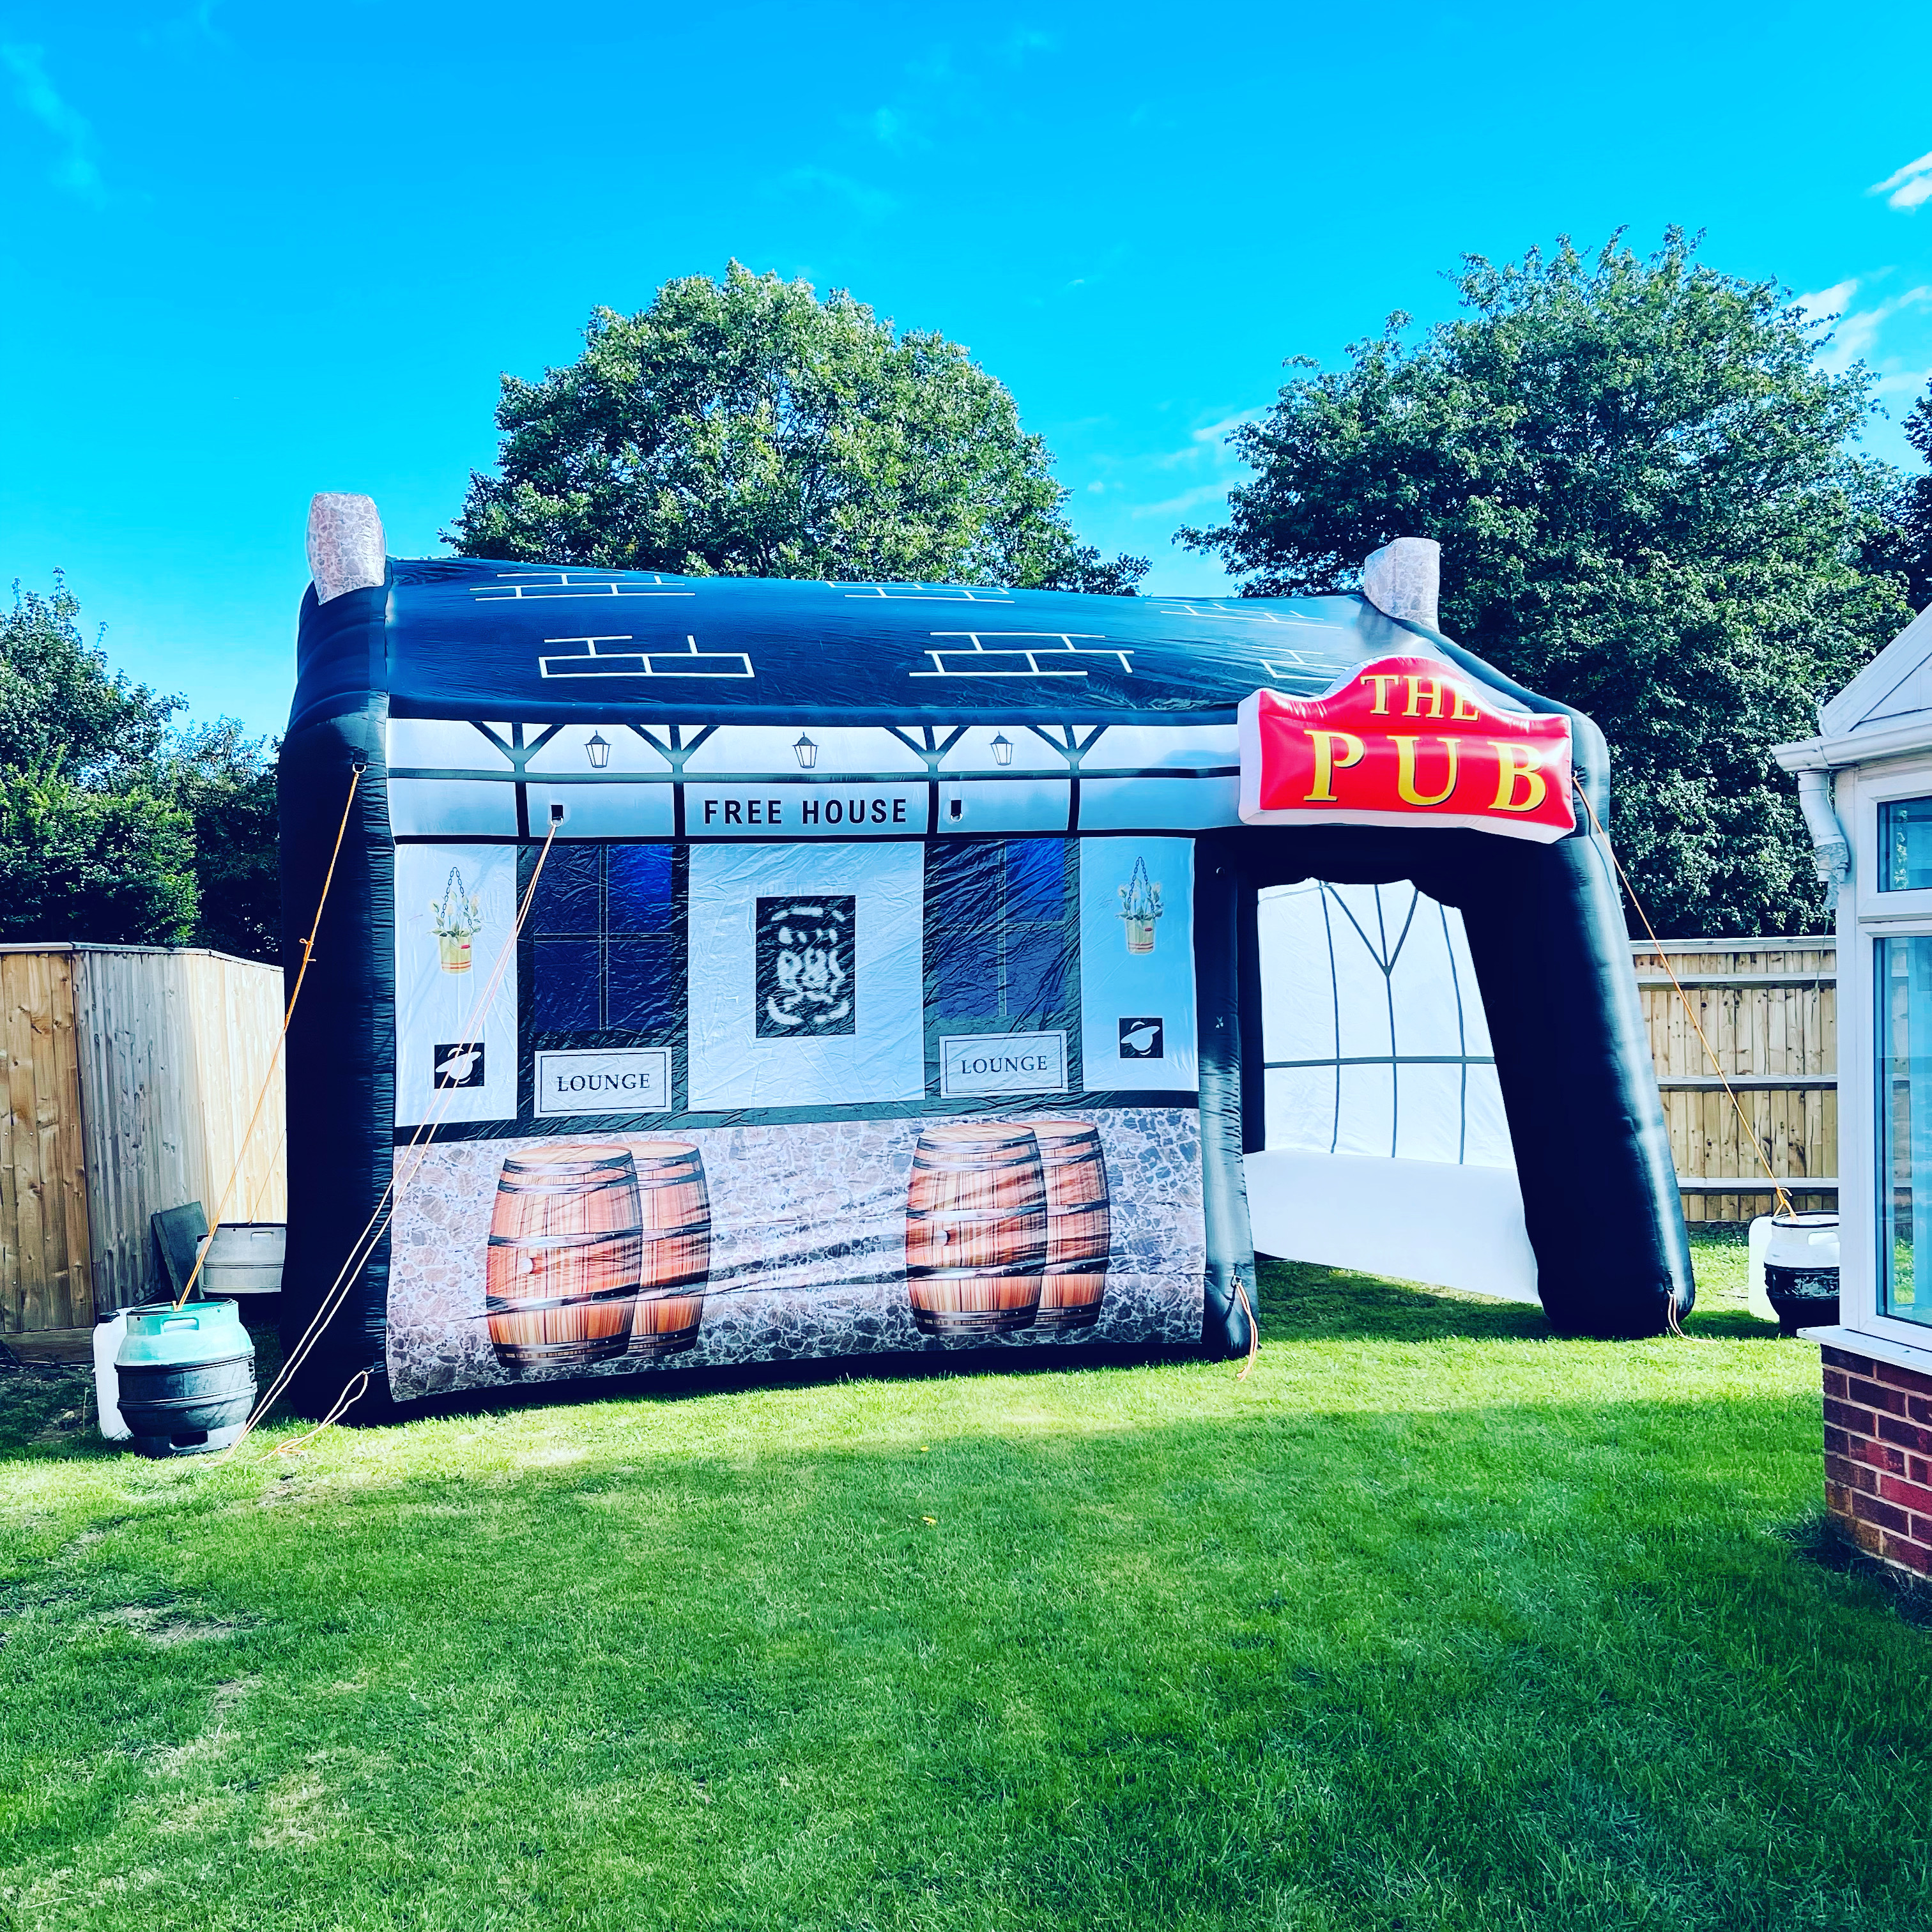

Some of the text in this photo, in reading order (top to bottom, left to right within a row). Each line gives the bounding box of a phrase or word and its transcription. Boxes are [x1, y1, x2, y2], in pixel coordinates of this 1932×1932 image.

[1361, 675, 1480, 721] THE
[1303, 730, 1547, 812] PUB
[705, 799, 906, 824] FREE HOUSE
[961, 1055, 1048, 1074] LOUNGE
[557, 1073, 650, 1091] LOUNGE
